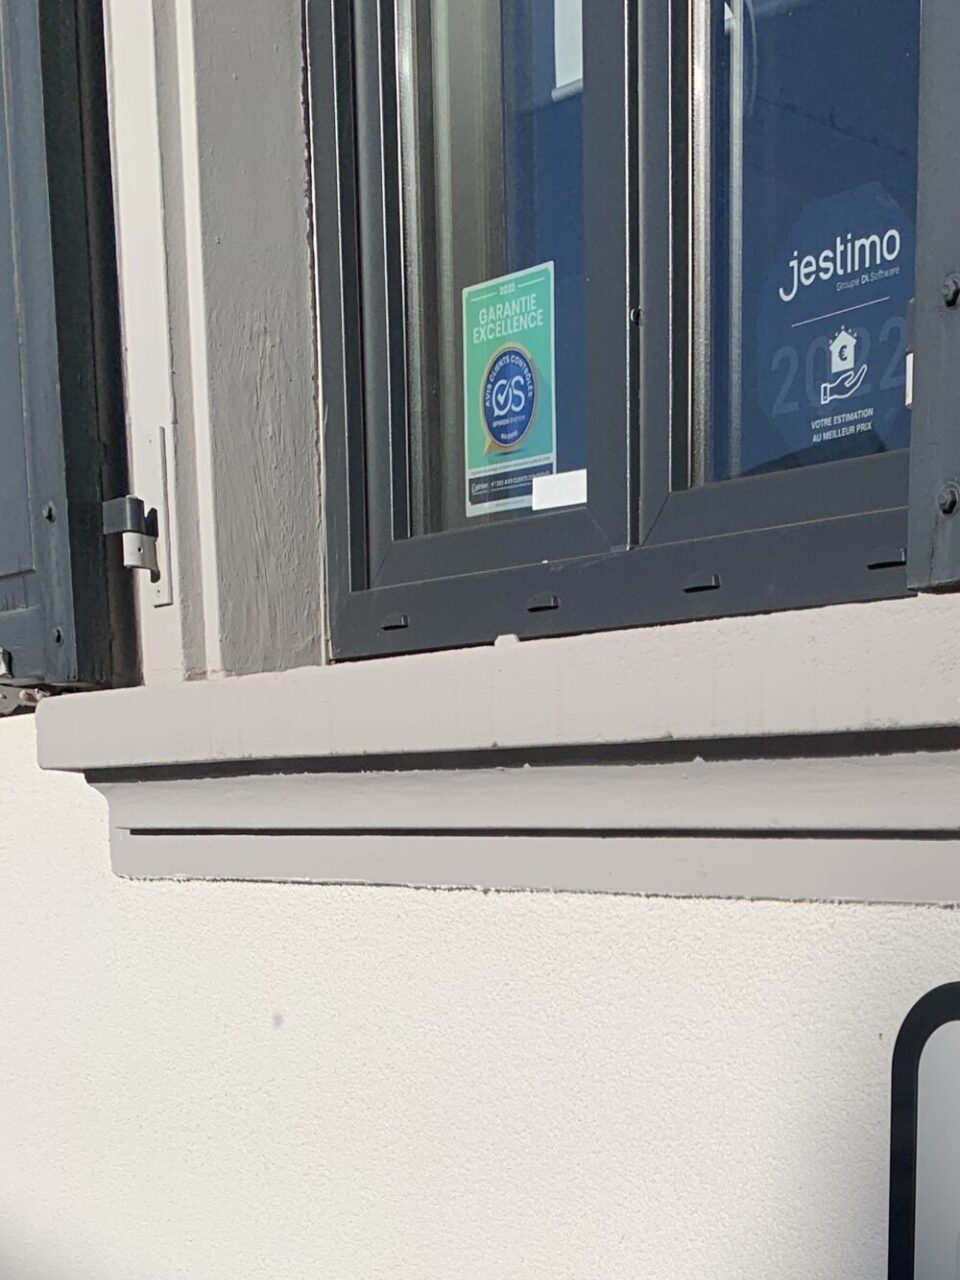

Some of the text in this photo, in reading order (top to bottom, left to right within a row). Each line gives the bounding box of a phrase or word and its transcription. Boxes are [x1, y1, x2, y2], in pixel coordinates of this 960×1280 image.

[779, 229, 901, 301] jestimo
[478, 294, 537, 325] GARANTIE
[473, 309, 543, 344] EXCELLENCE
[489, 355, 510, 382] CLIENTS
[811, 407, 874, 430] VOTRE ESTIMATION
[812, 421, 873, 443] AU MEILLEUR PRIX
